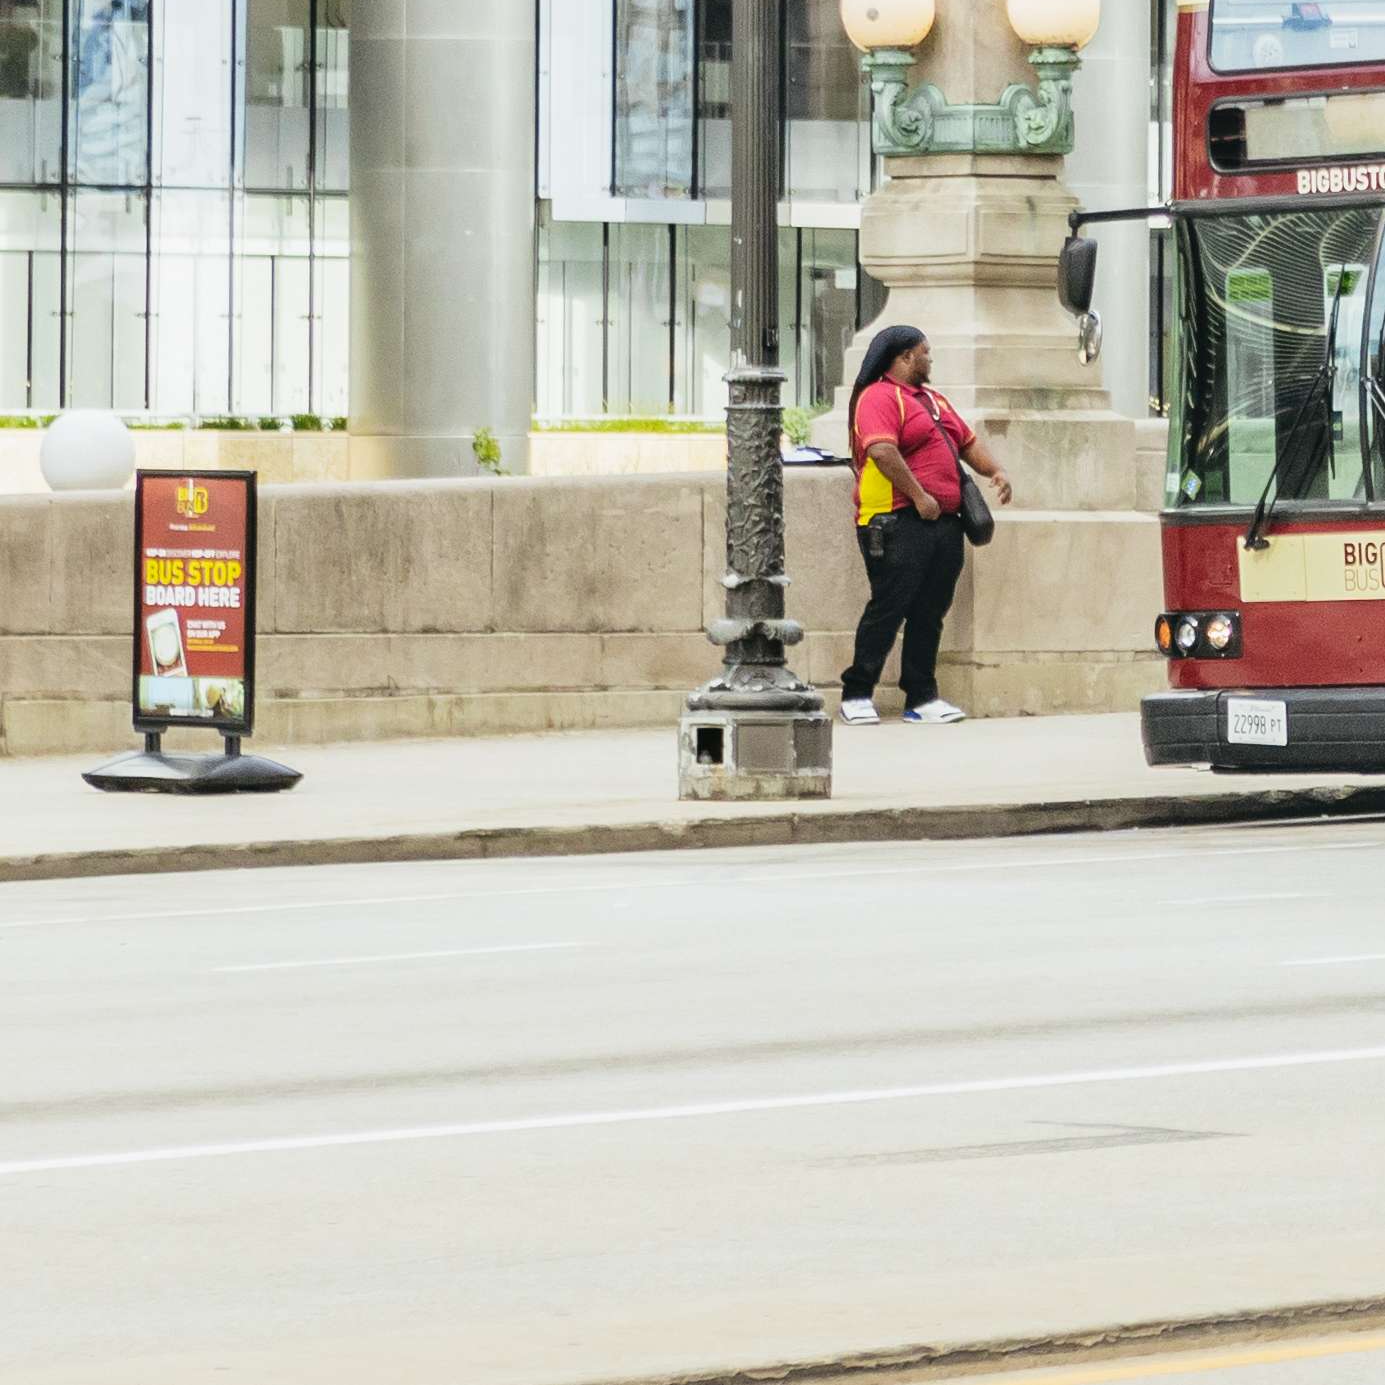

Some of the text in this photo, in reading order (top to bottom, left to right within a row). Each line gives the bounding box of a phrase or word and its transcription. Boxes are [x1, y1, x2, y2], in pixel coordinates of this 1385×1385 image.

[1344, 542, 1378, 566] BIG
[145, 558, 241, 586] BUS STOP
[1344, 568, 1380, 592] BUS
[144, 585, 241, 608] BOARD HERE
